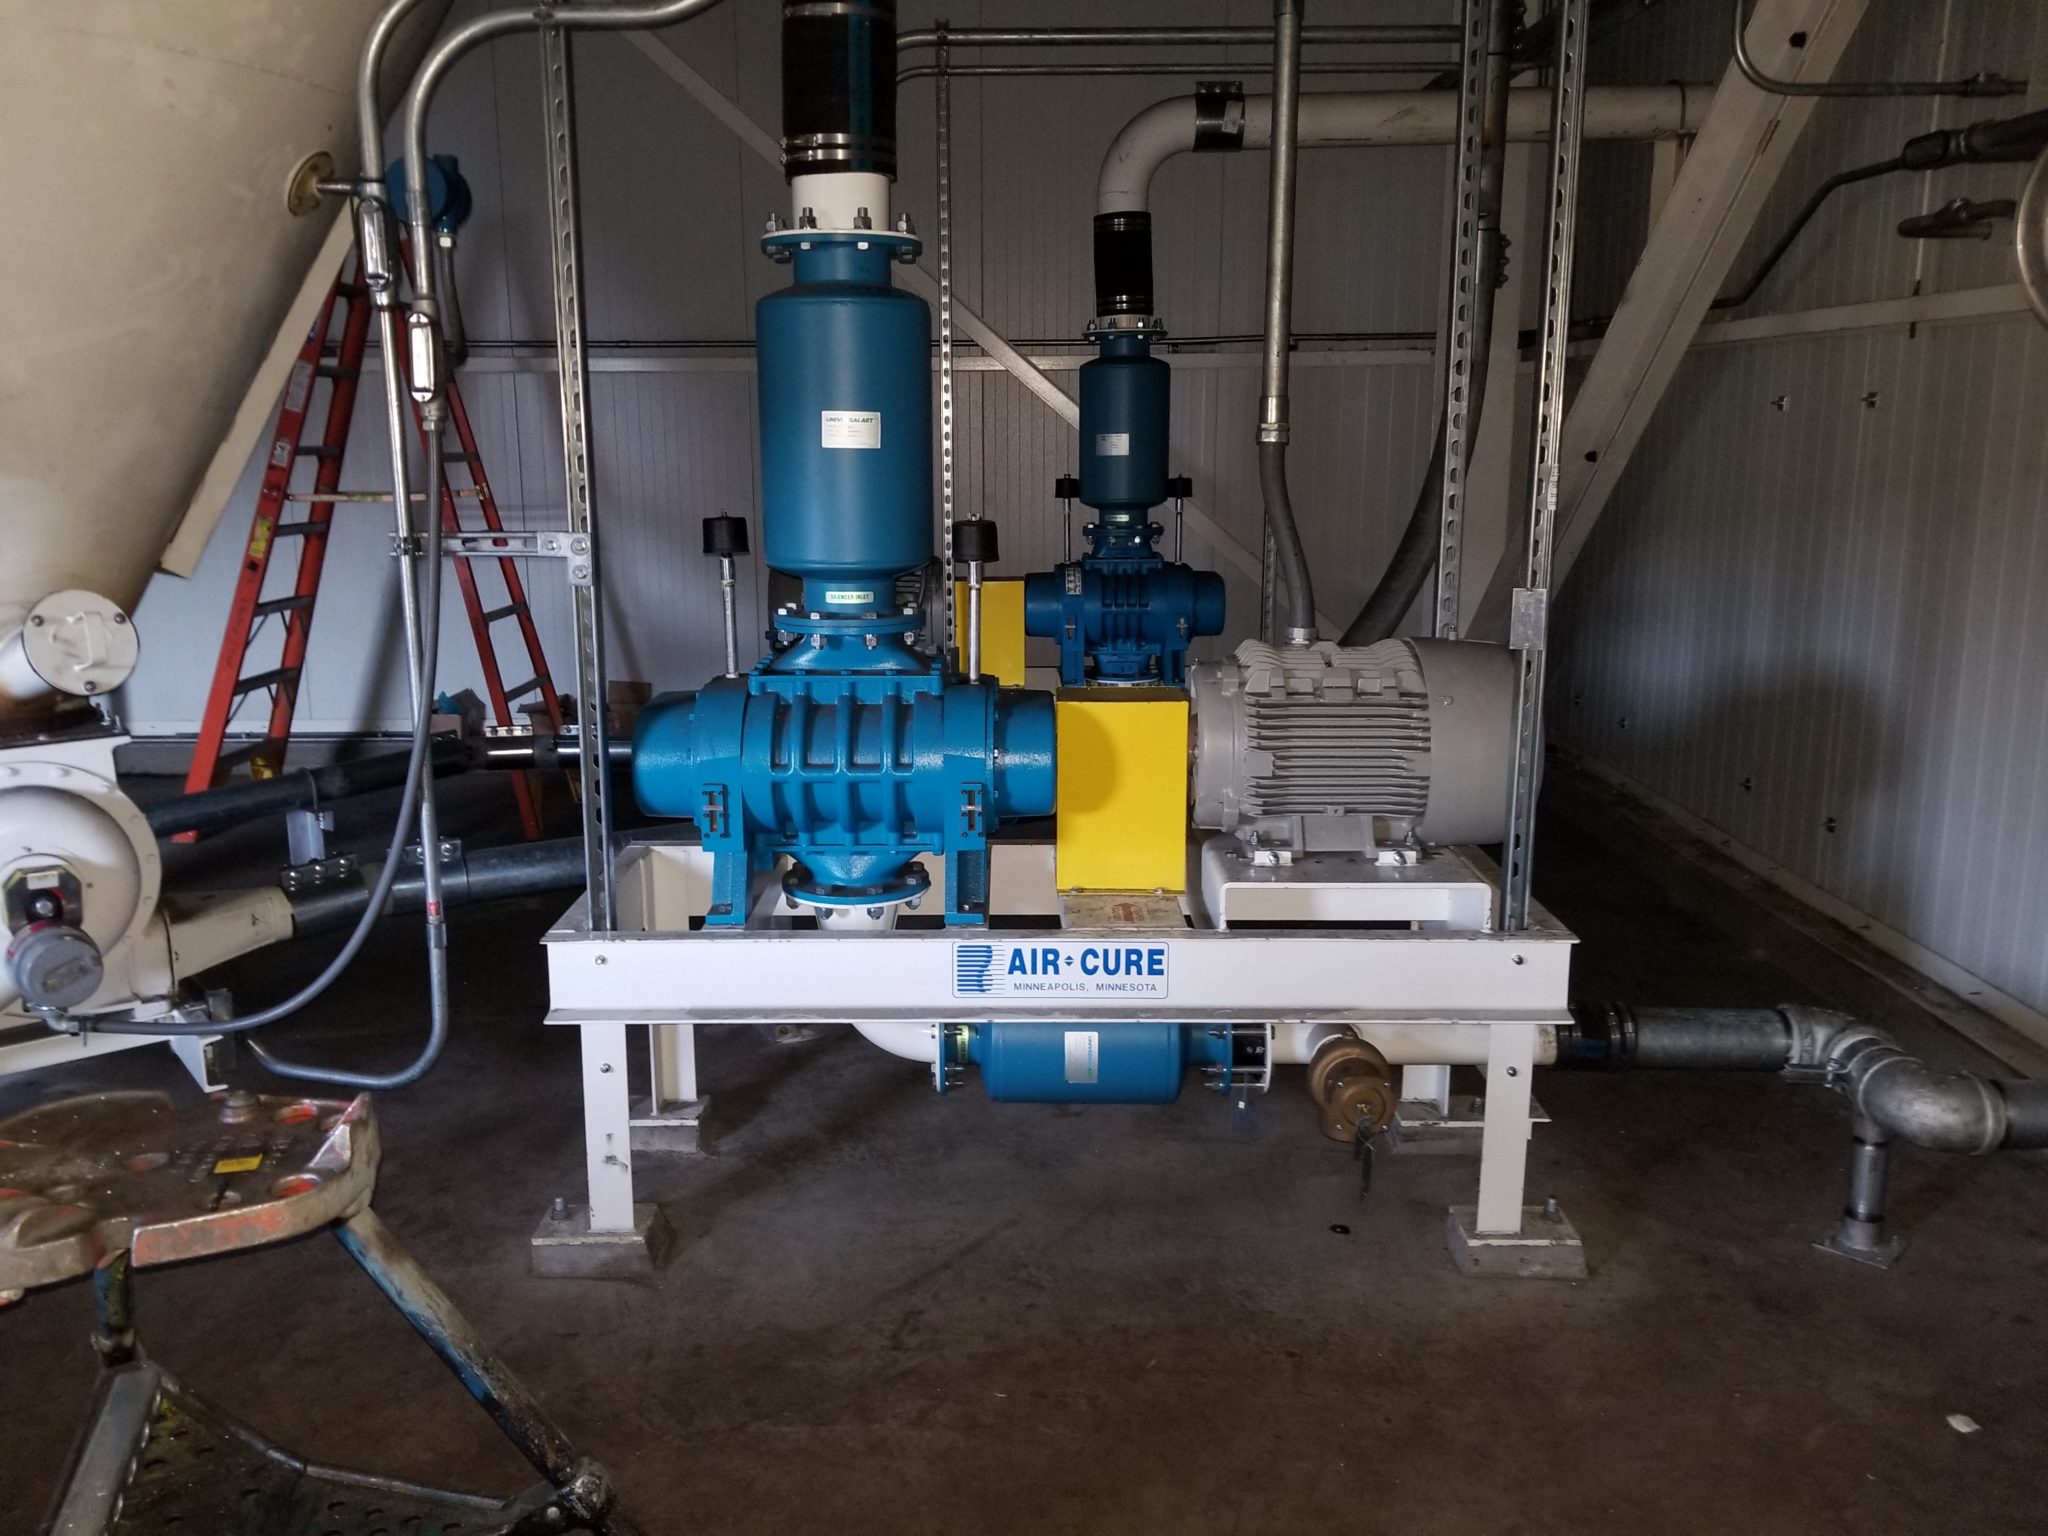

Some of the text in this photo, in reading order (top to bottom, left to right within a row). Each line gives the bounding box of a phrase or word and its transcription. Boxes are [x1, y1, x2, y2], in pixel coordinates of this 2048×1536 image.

[1008, 948, 1165, 976] AIR CURE
[1013, 983, 1157, 992] MINNEAPOLIS, MINNESOTA
